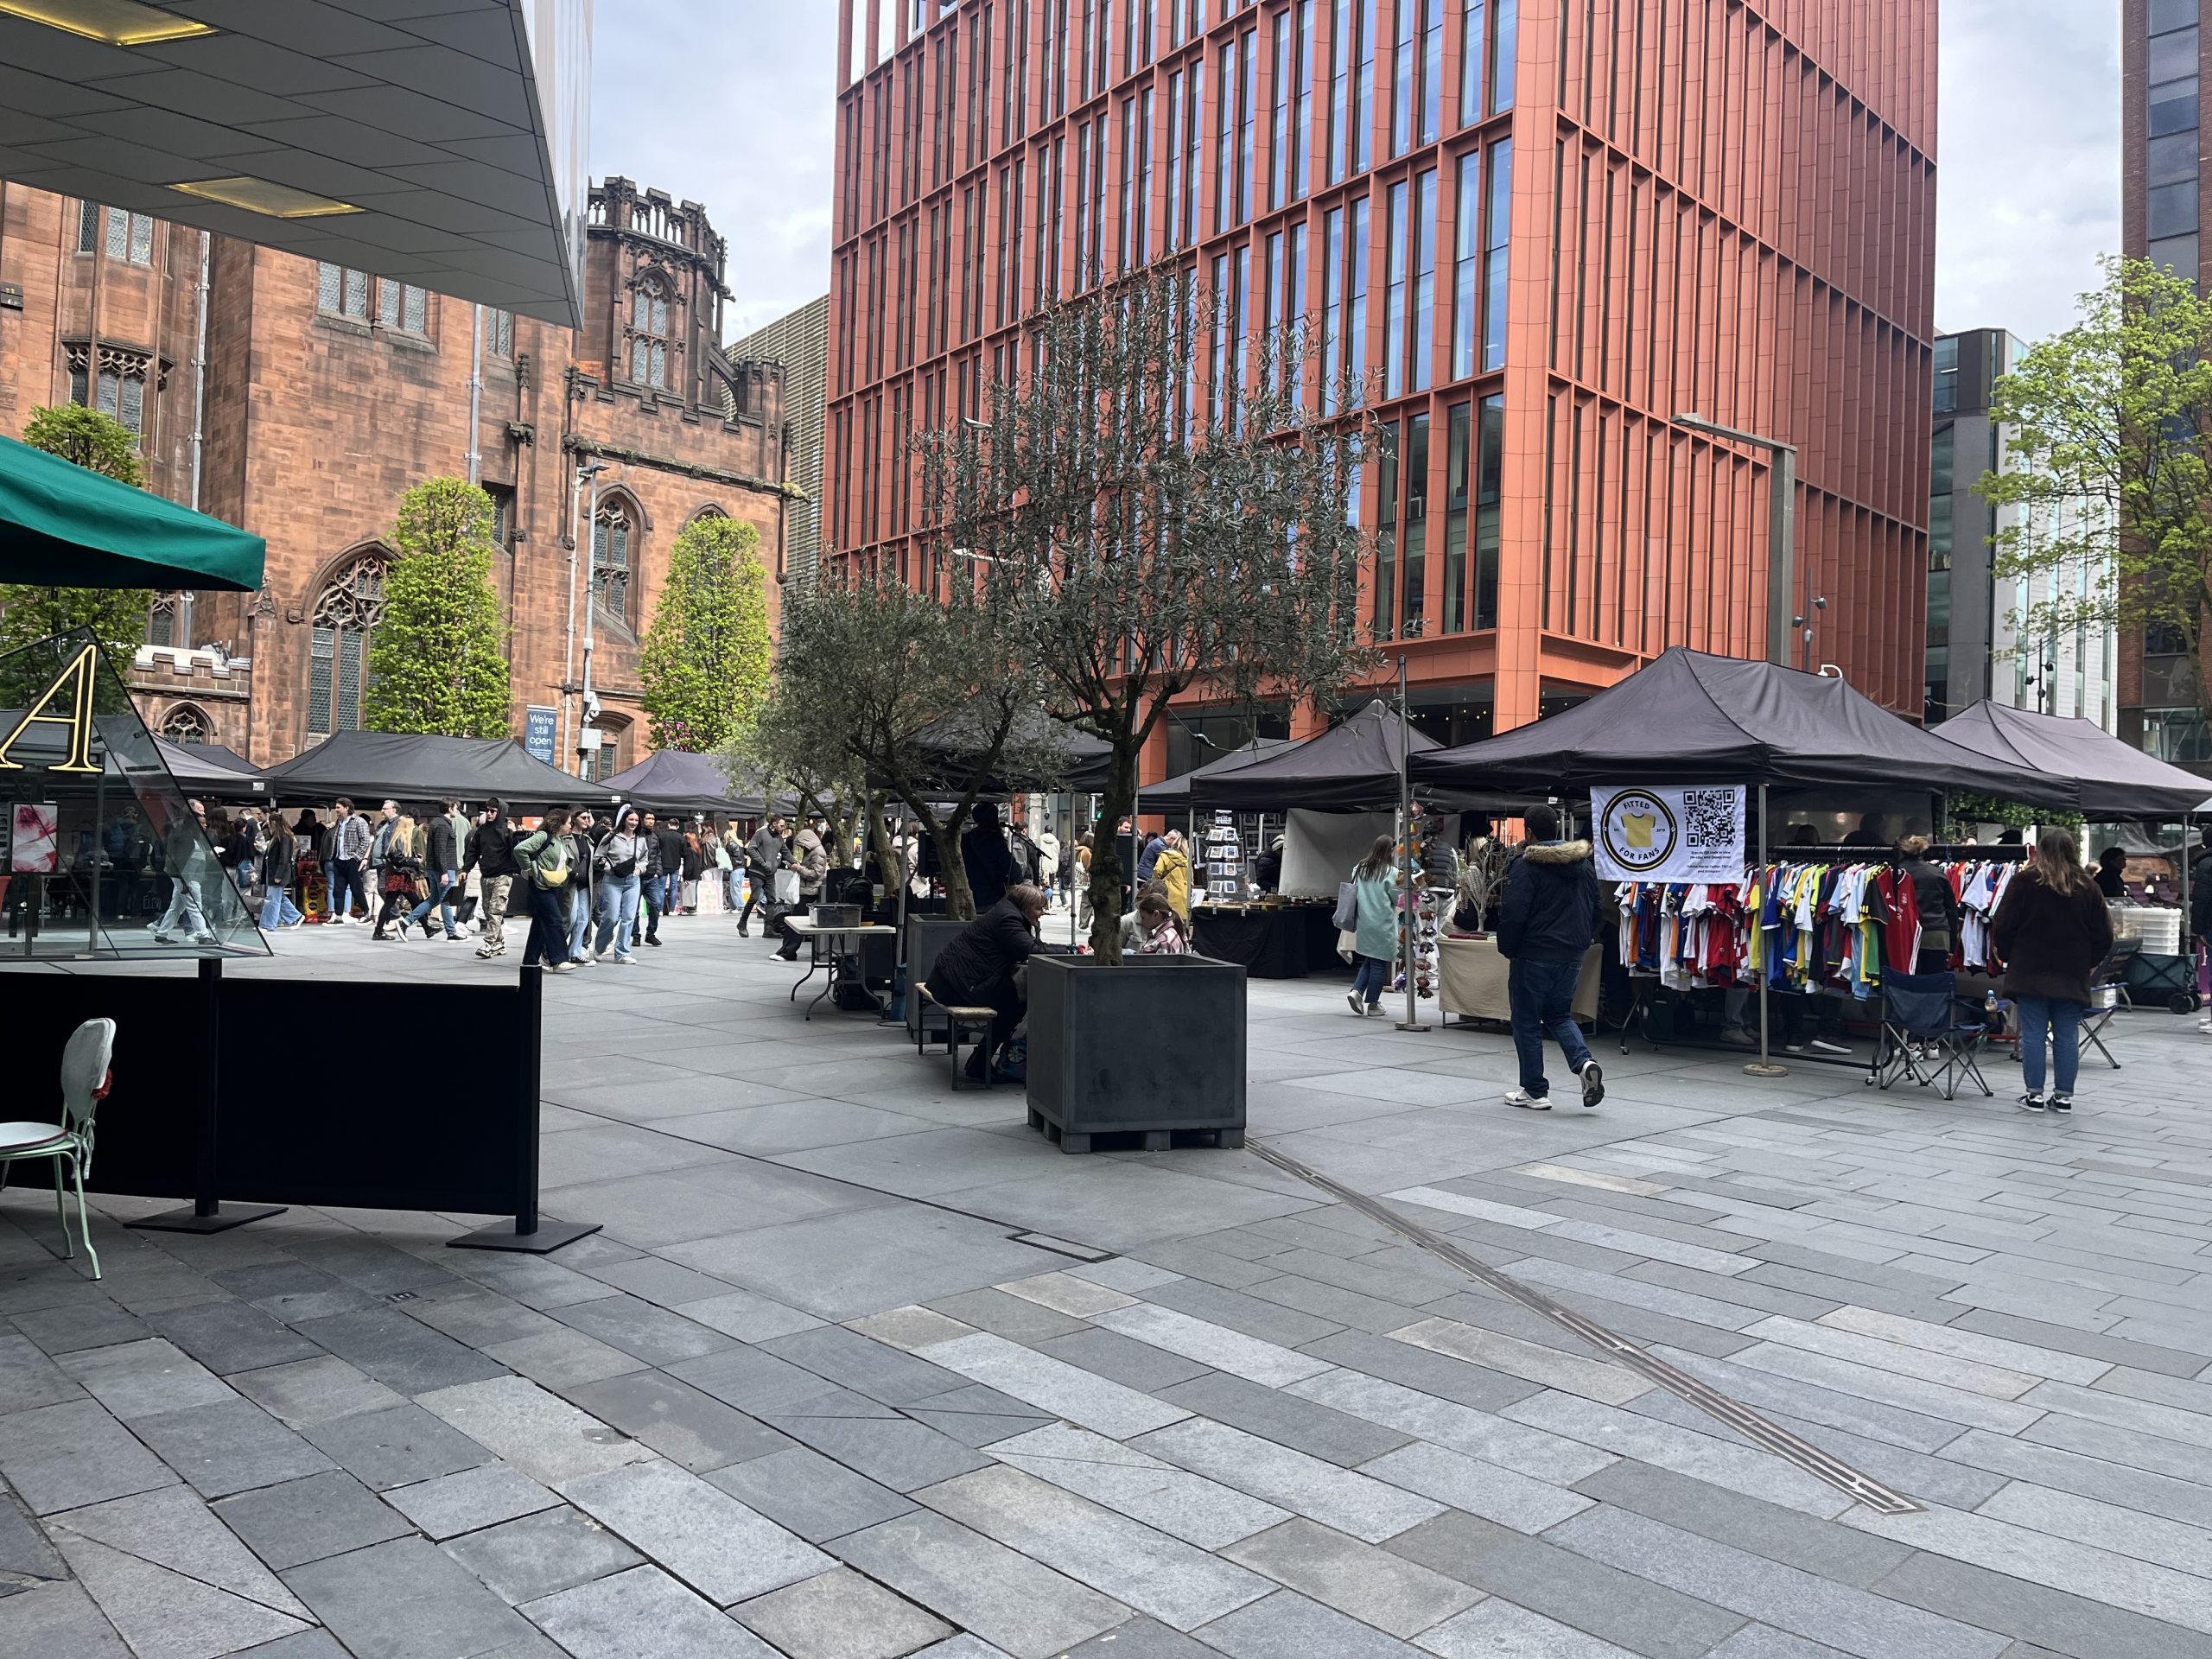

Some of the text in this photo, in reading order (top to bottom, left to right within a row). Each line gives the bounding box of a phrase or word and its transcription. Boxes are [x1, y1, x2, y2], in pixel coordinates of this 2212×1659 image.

[0, 644, 104, 772] A
[530, 714, 555, 725] We're
[534, 726, 549, 735] still
[529, 737, 552, 746] open
[1623, 800, 1650, 810] FITTED
[1619, 847, 1660, 861] FOR FANS
